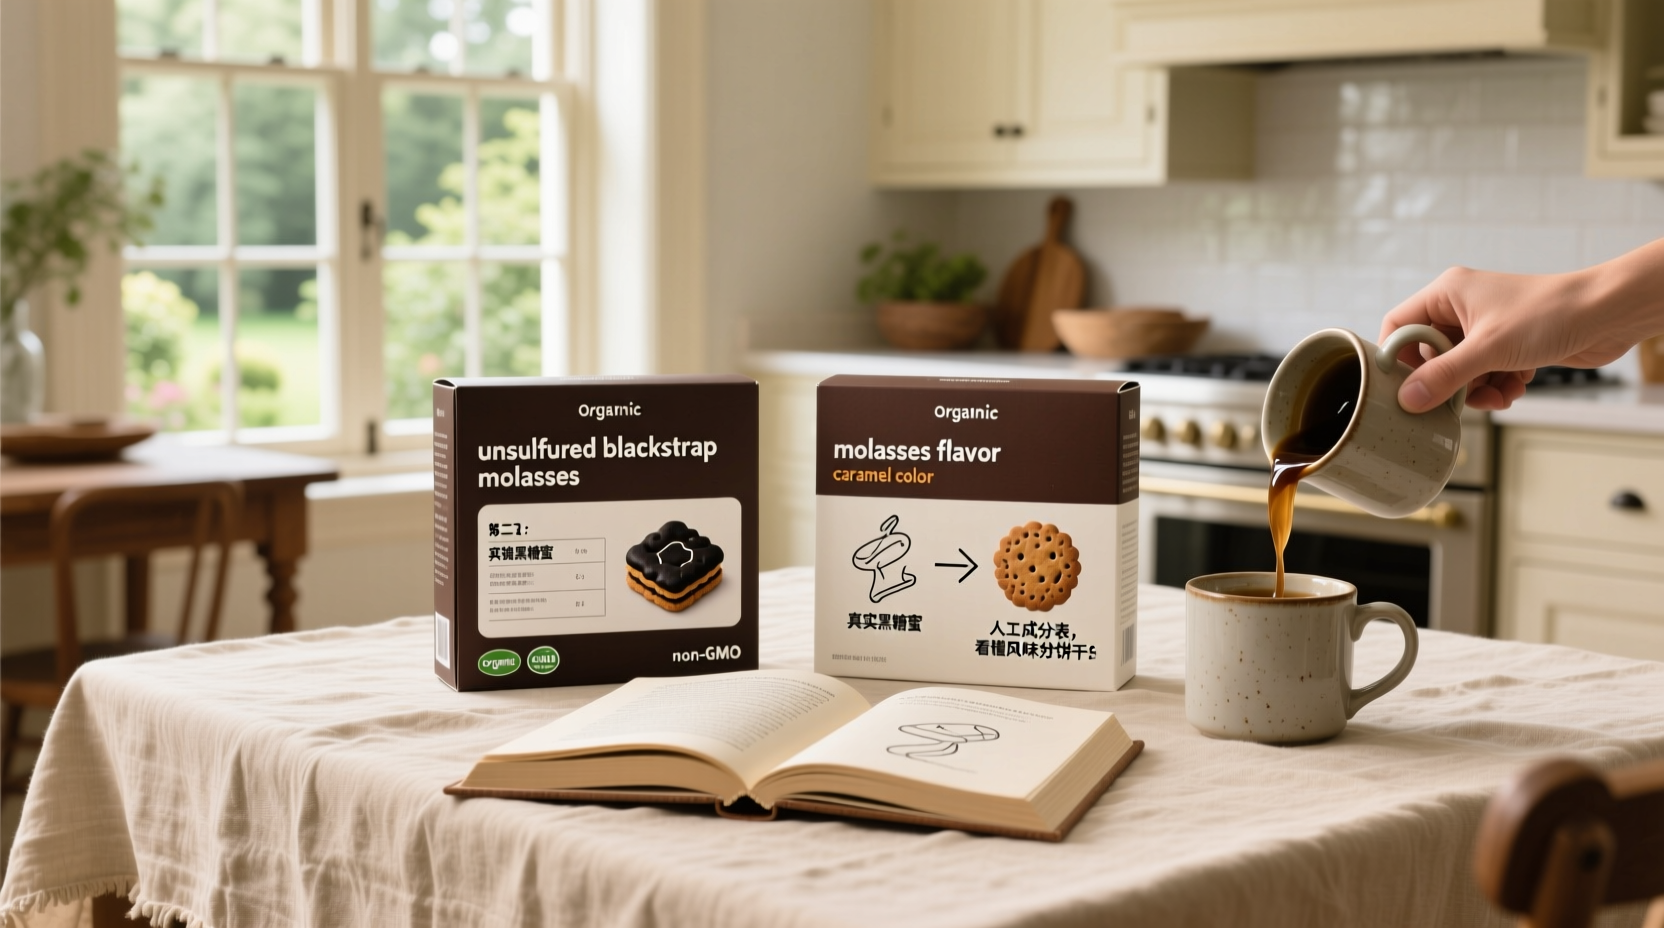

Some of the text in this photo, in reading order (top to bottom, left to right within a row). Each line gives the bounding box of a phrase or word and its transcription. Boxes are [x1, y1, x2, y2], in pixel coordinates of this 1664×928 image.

[478, 435, 718, 463] unsulfured blackstrap
[834, 438, 1001, 463] molasses flavor
[478, 465, 580, 488] molasses
[832, 466, 935, 484] caramel color
[672, 645, 742, 662] non-GMO
